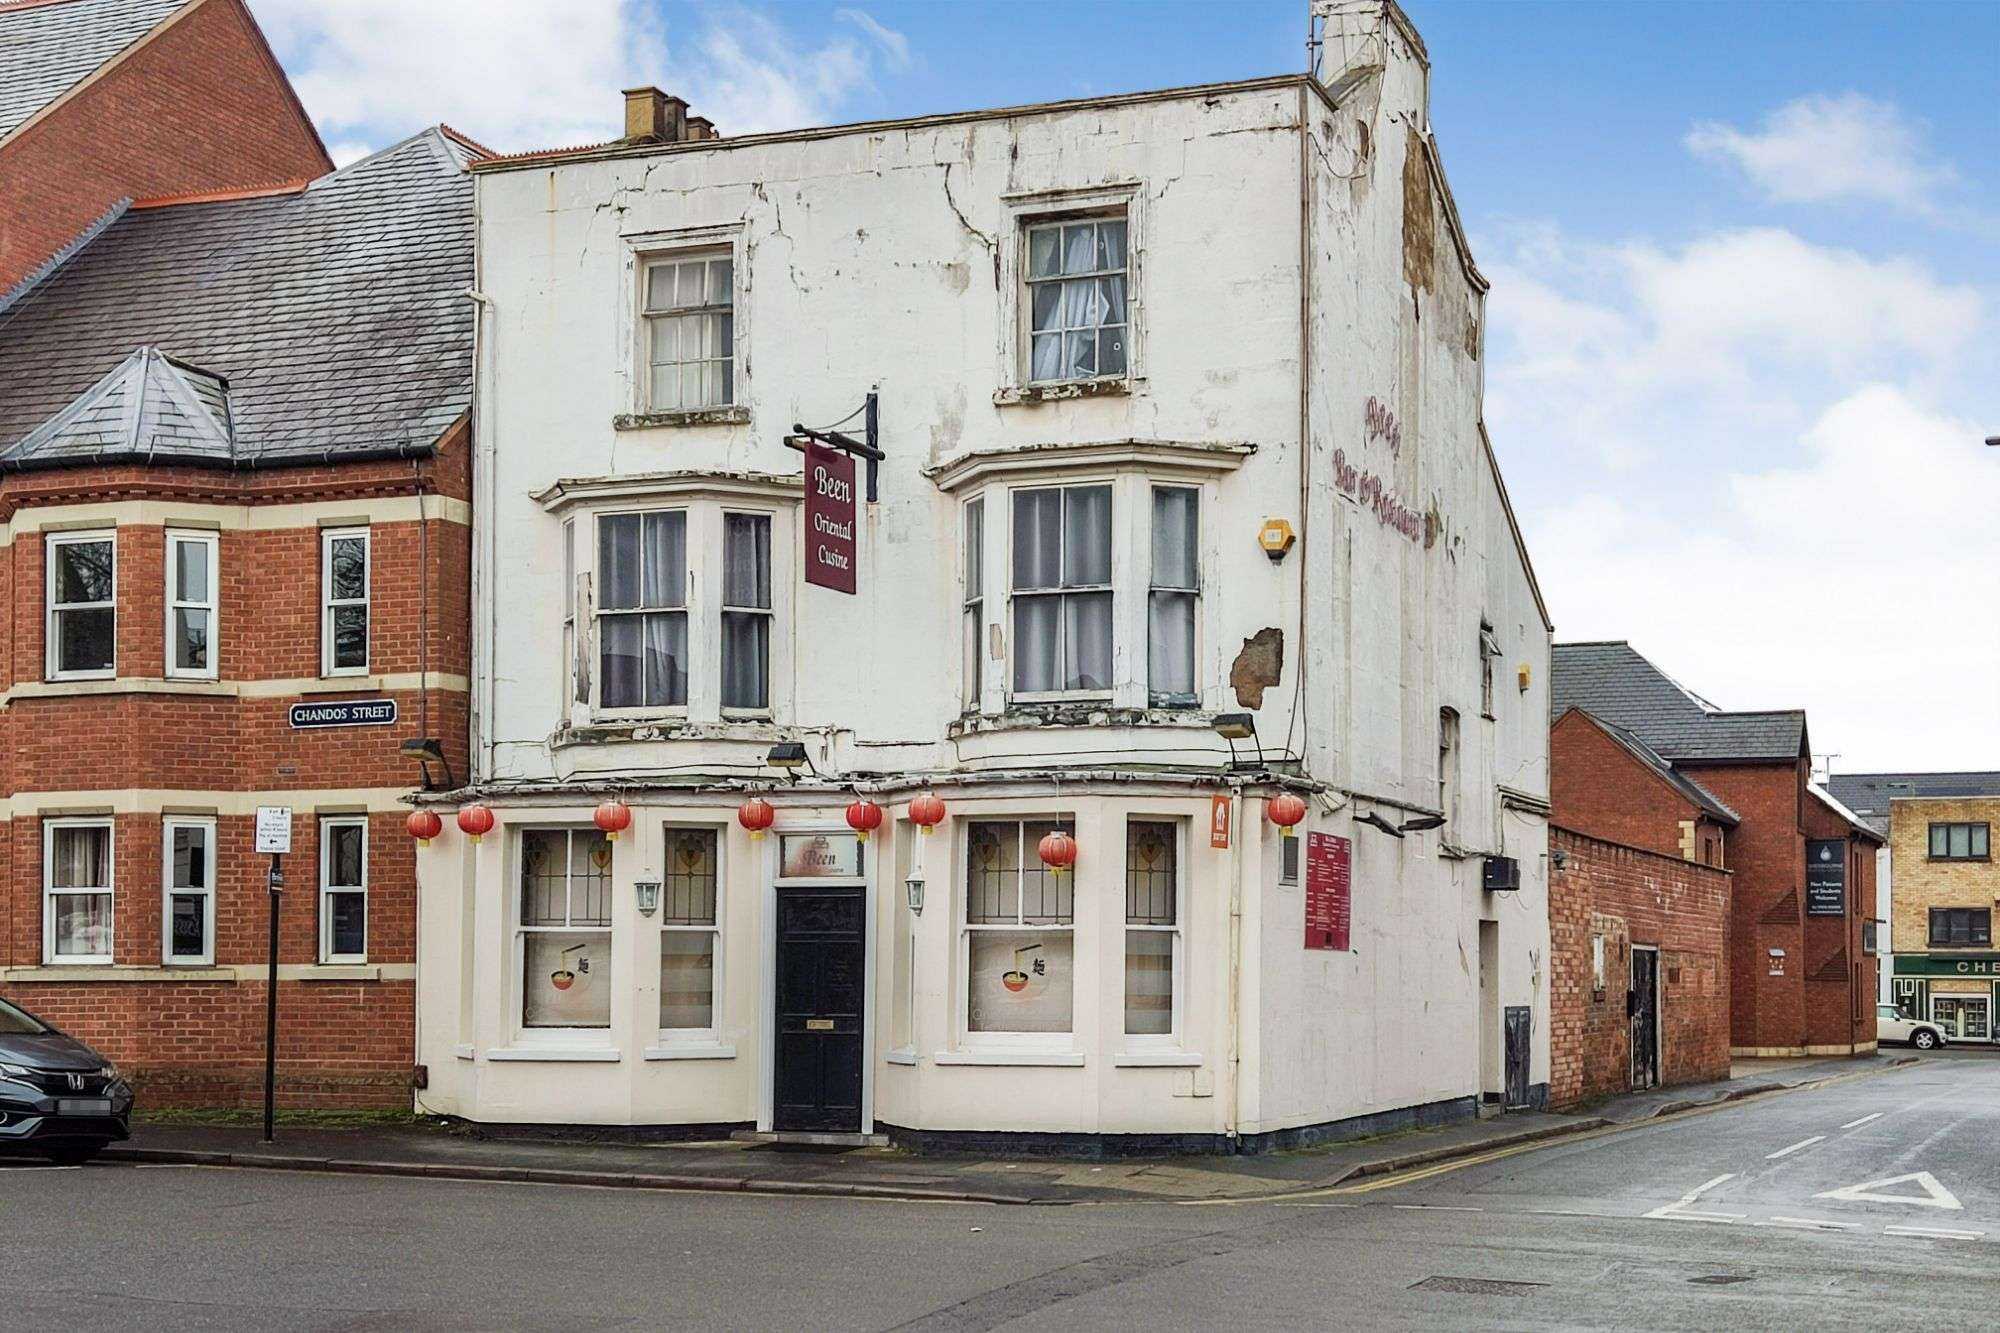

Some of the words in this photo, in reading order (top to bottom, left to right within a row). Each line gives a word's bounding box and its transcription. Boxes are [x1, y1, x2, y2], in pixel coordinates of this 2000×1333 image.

[814, 465, 852, 504] Been
[814, 512, 852, 541] Oriental
[818, 544, 849, 570] Cusine
[294, 707, 348, 721] CHANDOS
[352, 705, 392, 719] STREET
[1956, 961, 2000, 973] CHE
